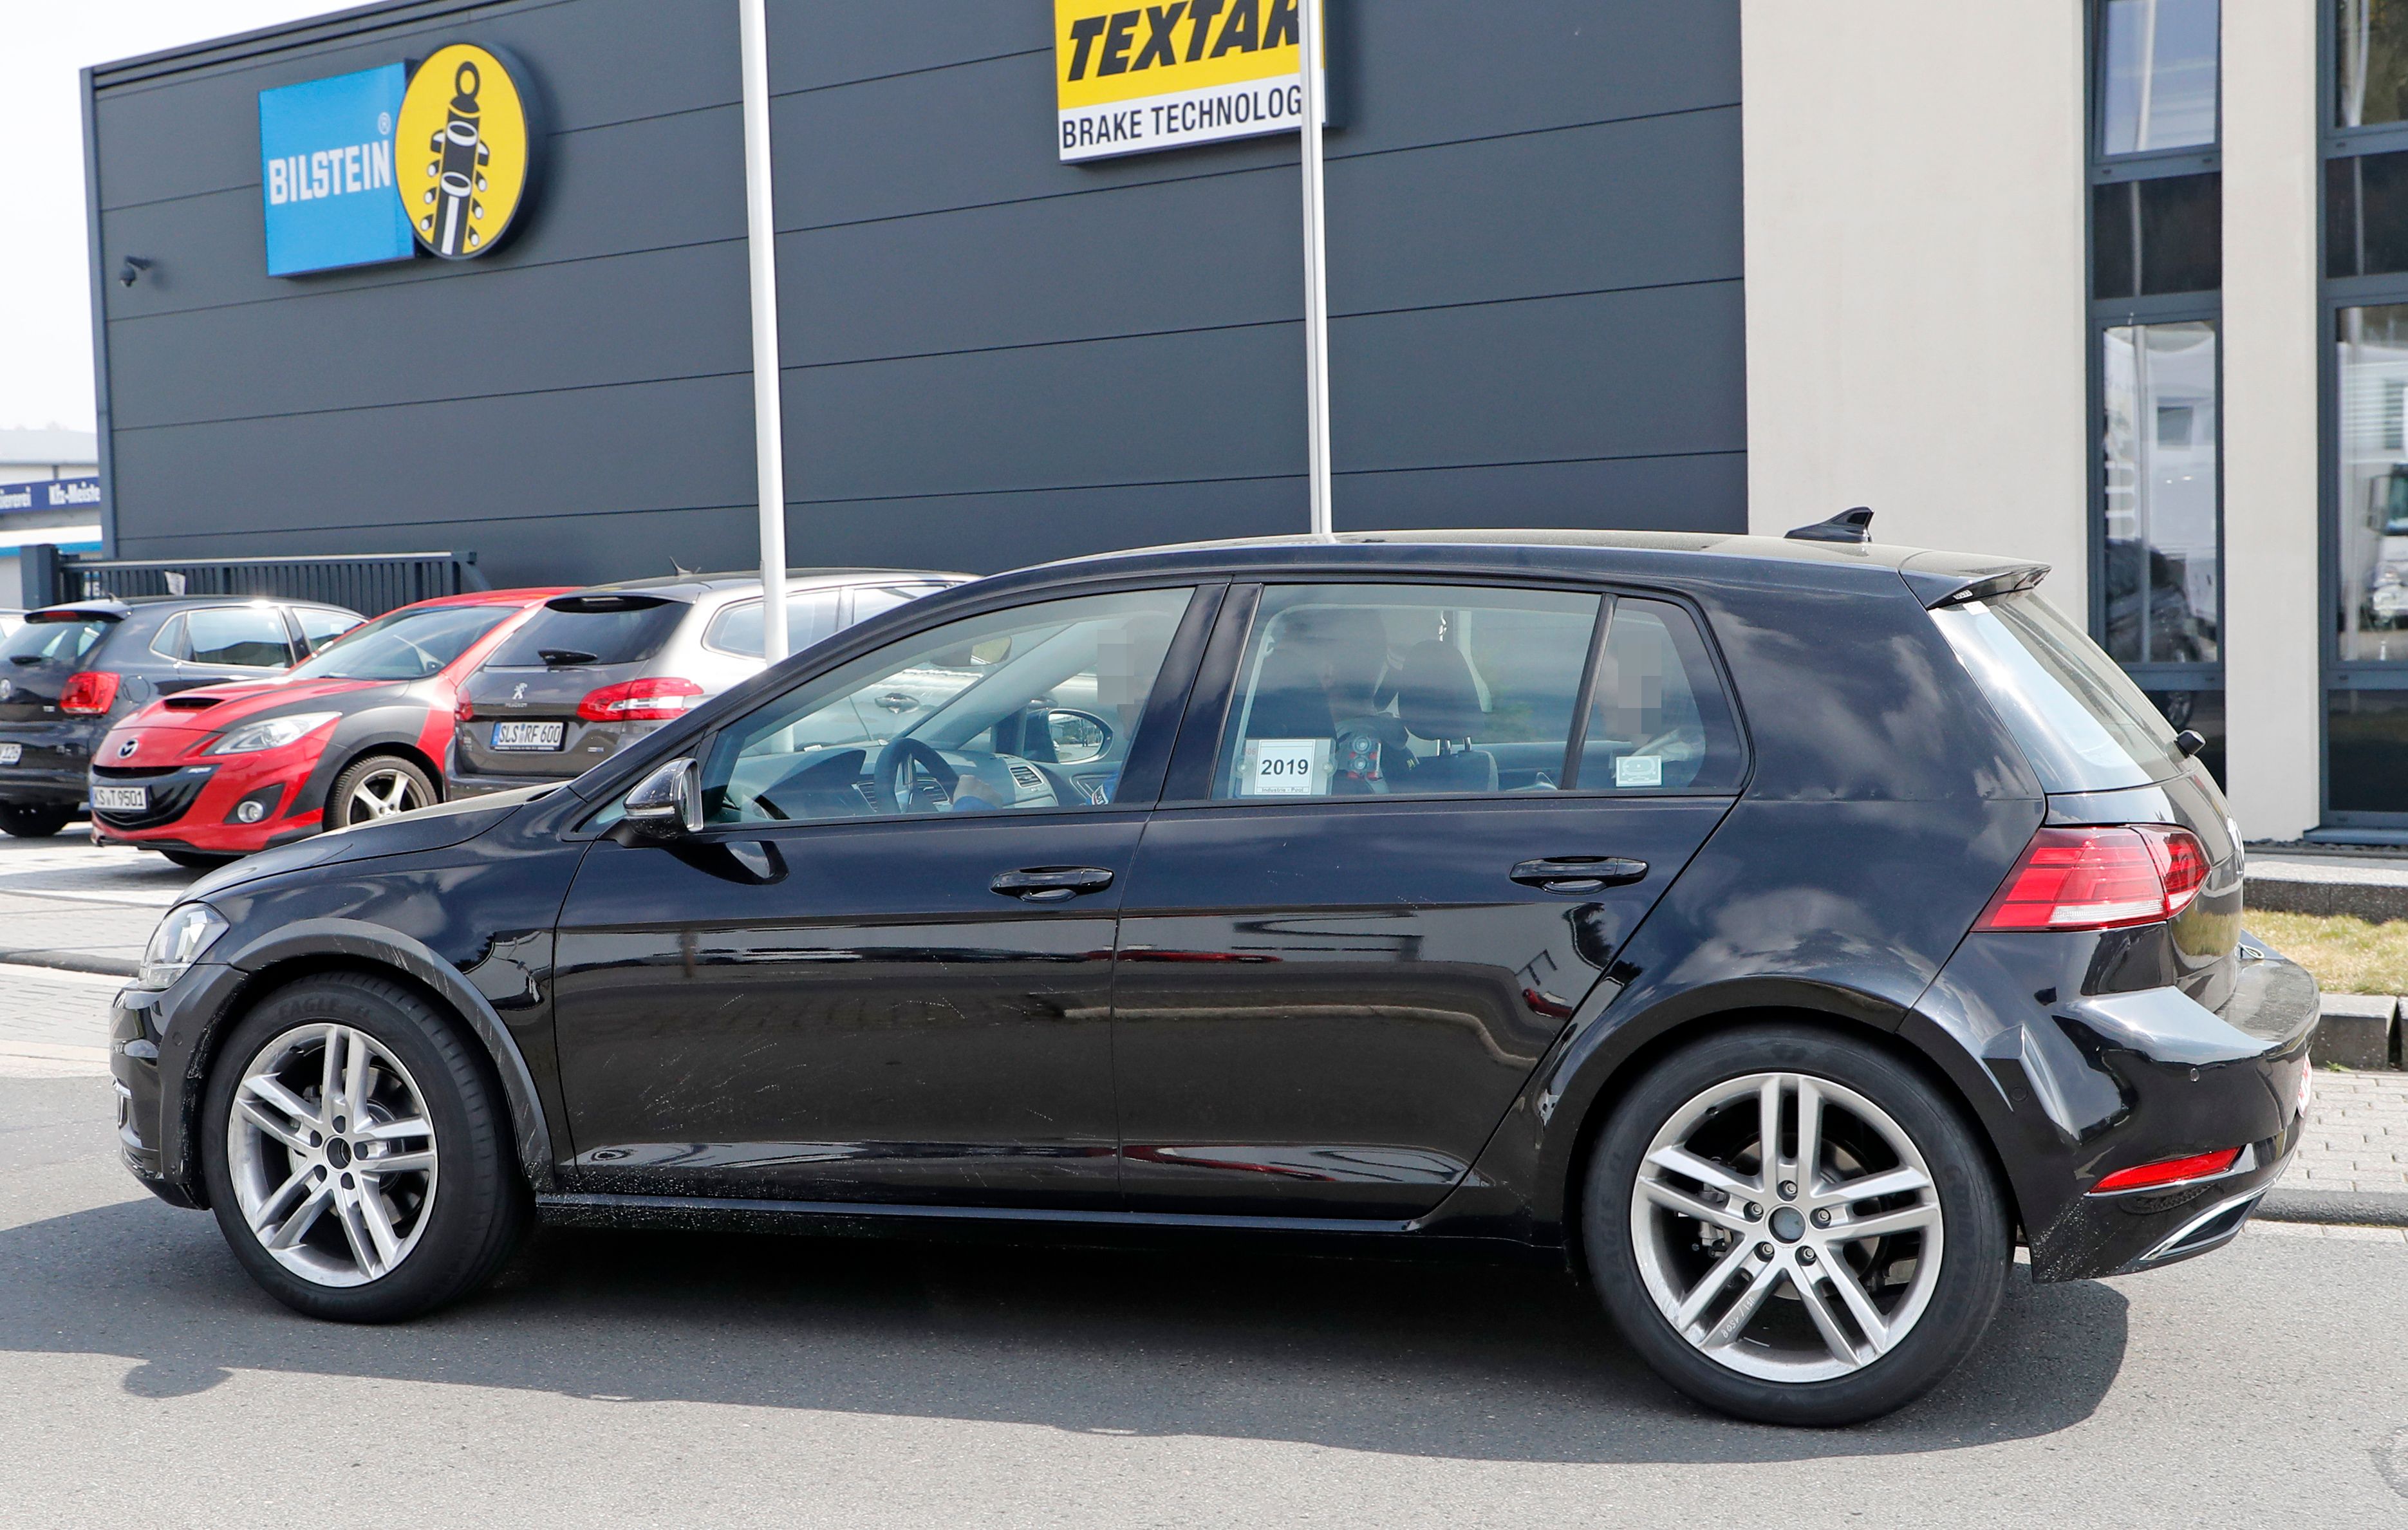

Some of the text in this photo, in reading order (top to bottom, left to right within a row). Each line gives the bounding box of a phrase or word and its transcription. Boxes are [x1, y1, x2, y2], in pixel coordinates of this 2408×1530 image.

[1063, 84, 1302, 149] BRAKE TECHNOLOG
[268, 140, 391, 205] BILSTEIN
[499, 725, 561, 743] SLS RF 600
[1260, 758, 1309, 775] 2019
[110, 790, 117, 805] T
[118, 790, 144, 807] 9501
